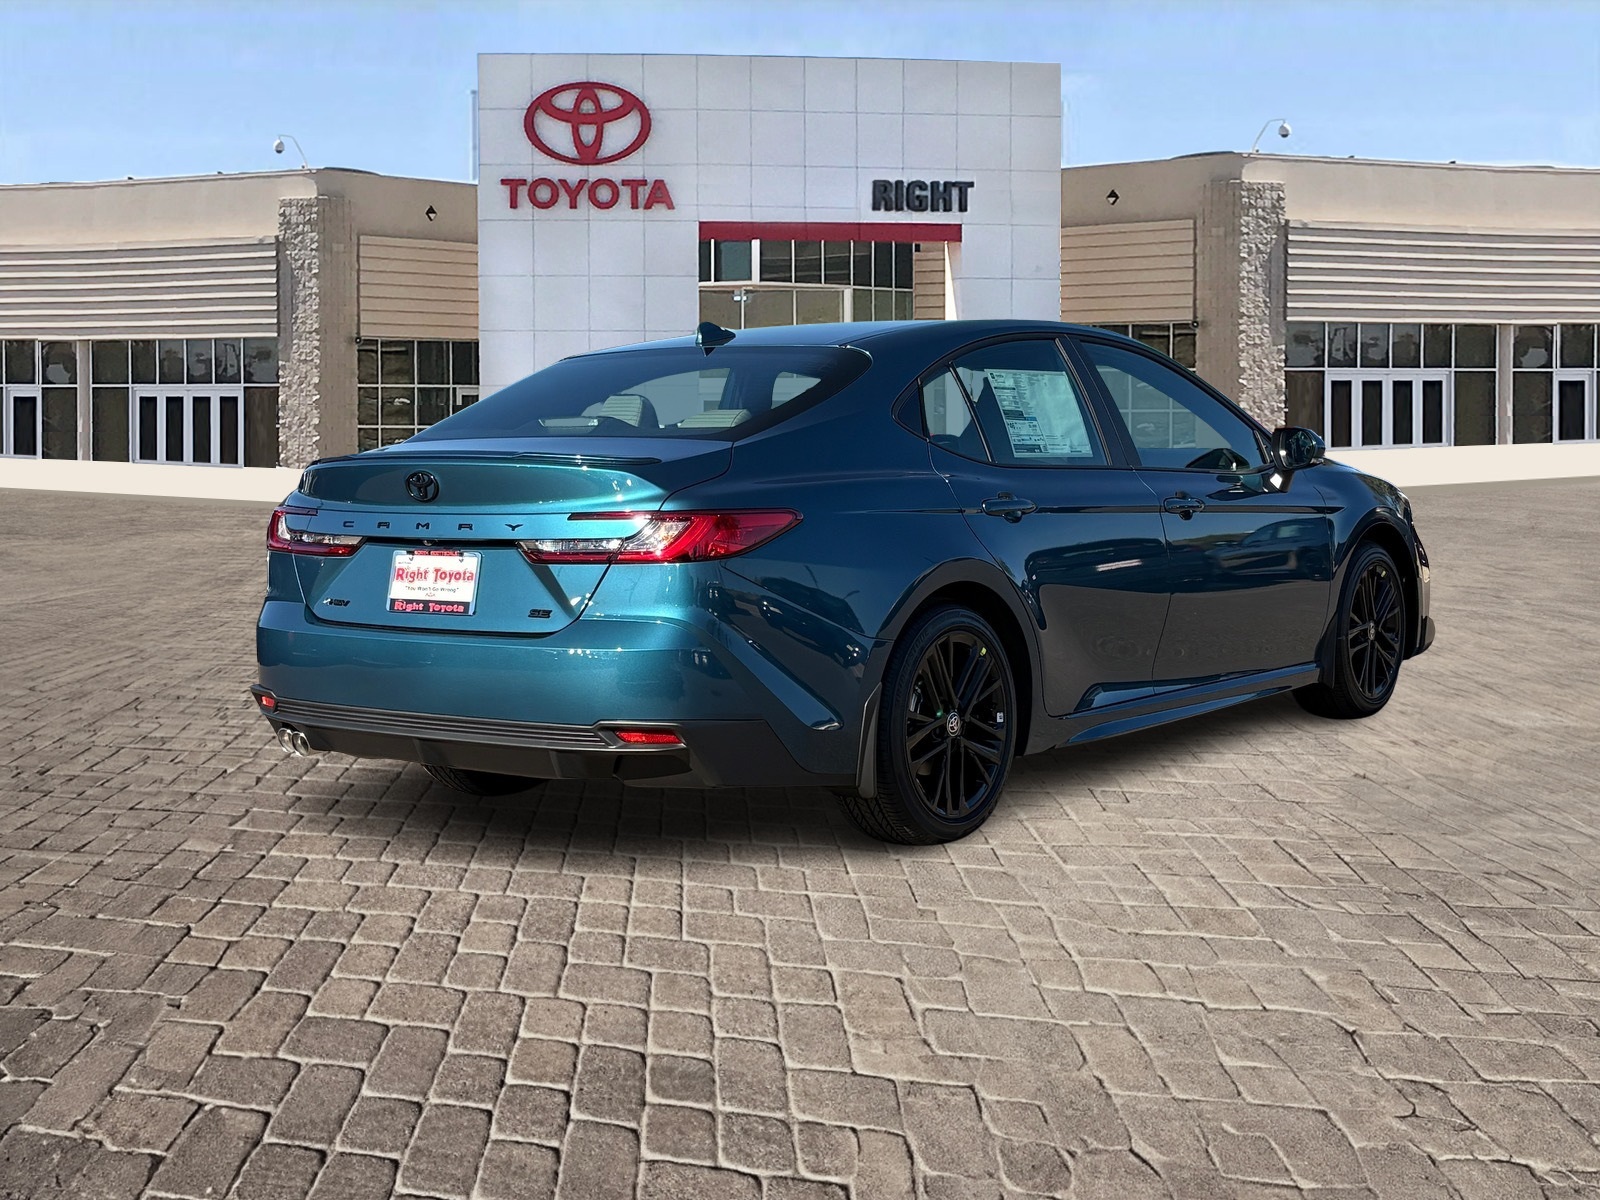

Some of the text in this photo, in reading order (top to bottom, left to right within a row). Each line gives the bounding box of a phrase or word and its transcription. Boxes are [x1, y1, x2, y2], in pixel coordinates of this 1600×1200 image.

[500, 177, 675, 210] TOYOTA
[872, 179, 975, 212] RIGHT
[343, 520, 524, 531] CAMRY
[396, 567, 475, 583] Right Toyota
[394, 600, 465, 613] Right Toyota
[528, 608, 552, 618] SE
